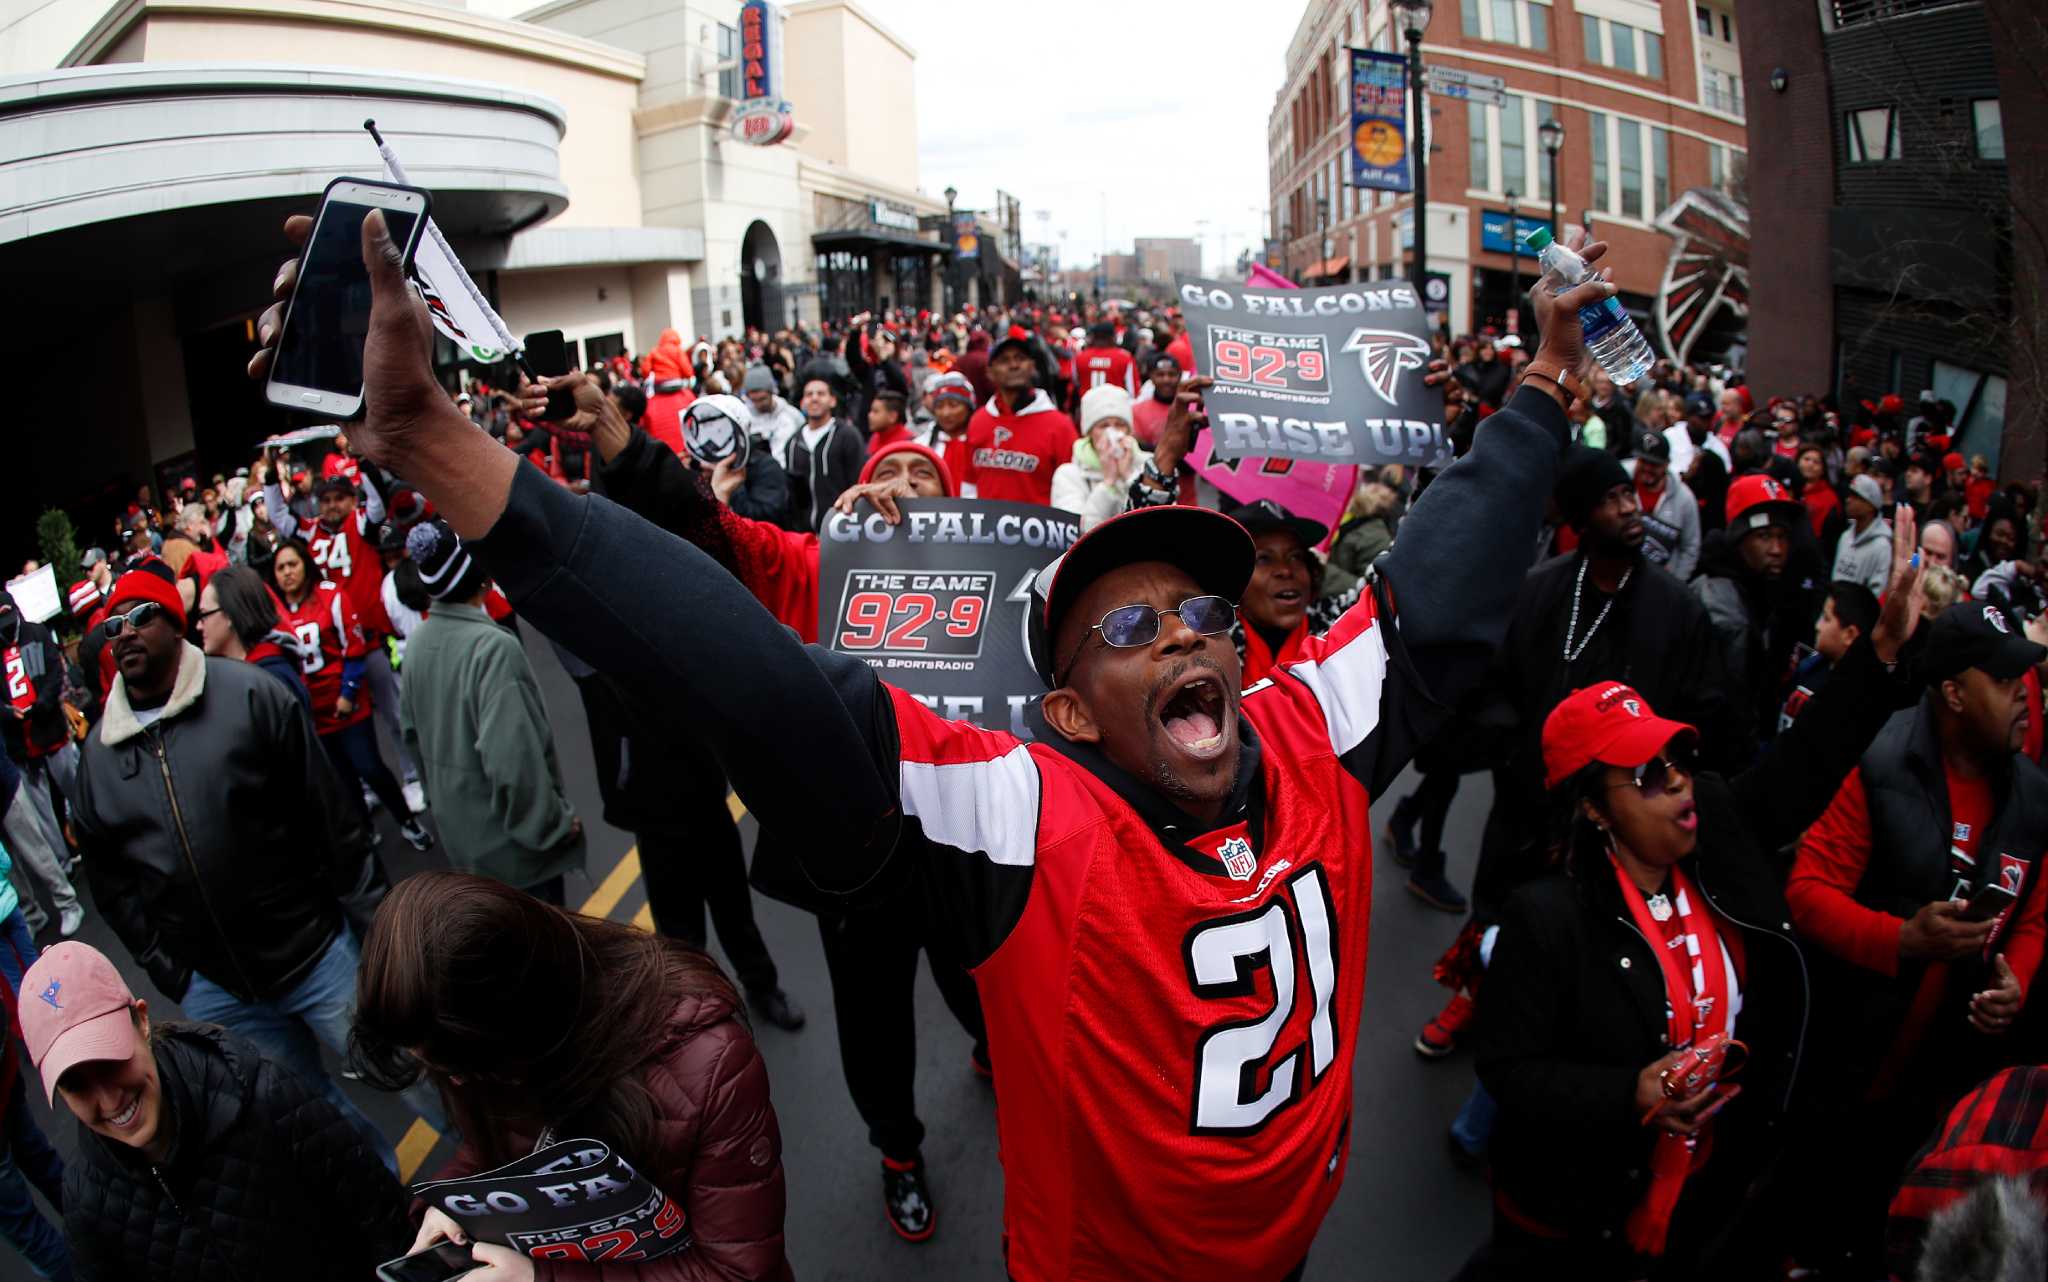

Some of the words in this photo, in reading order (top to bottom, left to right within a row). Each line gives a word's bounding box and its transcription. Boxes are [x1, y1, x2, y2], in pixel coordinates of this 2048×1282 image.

[743, 7, 765, 98] REGAL
[1181, 284, 1233, 311] GO
[1242, 289, 1417, 317] FALCONS
[1214, 328, 1254, 344] THE
[1260, 335, 1320, 349] GAME
[1213, 384, 1258, 397] ATLANTA
[1218, 413, 1354, 456] RISE
[1366, 419, 1445, 460] UP!
[828, 510, 895, 543] GO
[908, 512, 1079, 550] FALCONS
[855, 574, 906, 591] THE
[912, 576, 987, 592] GAME
[1229, 853, 1253, 875] NFL
[1188, 866, 1339, 1132] 21
[444, 1191, 529, 1217] GO
[518, 1228, 581, 1244] THE
